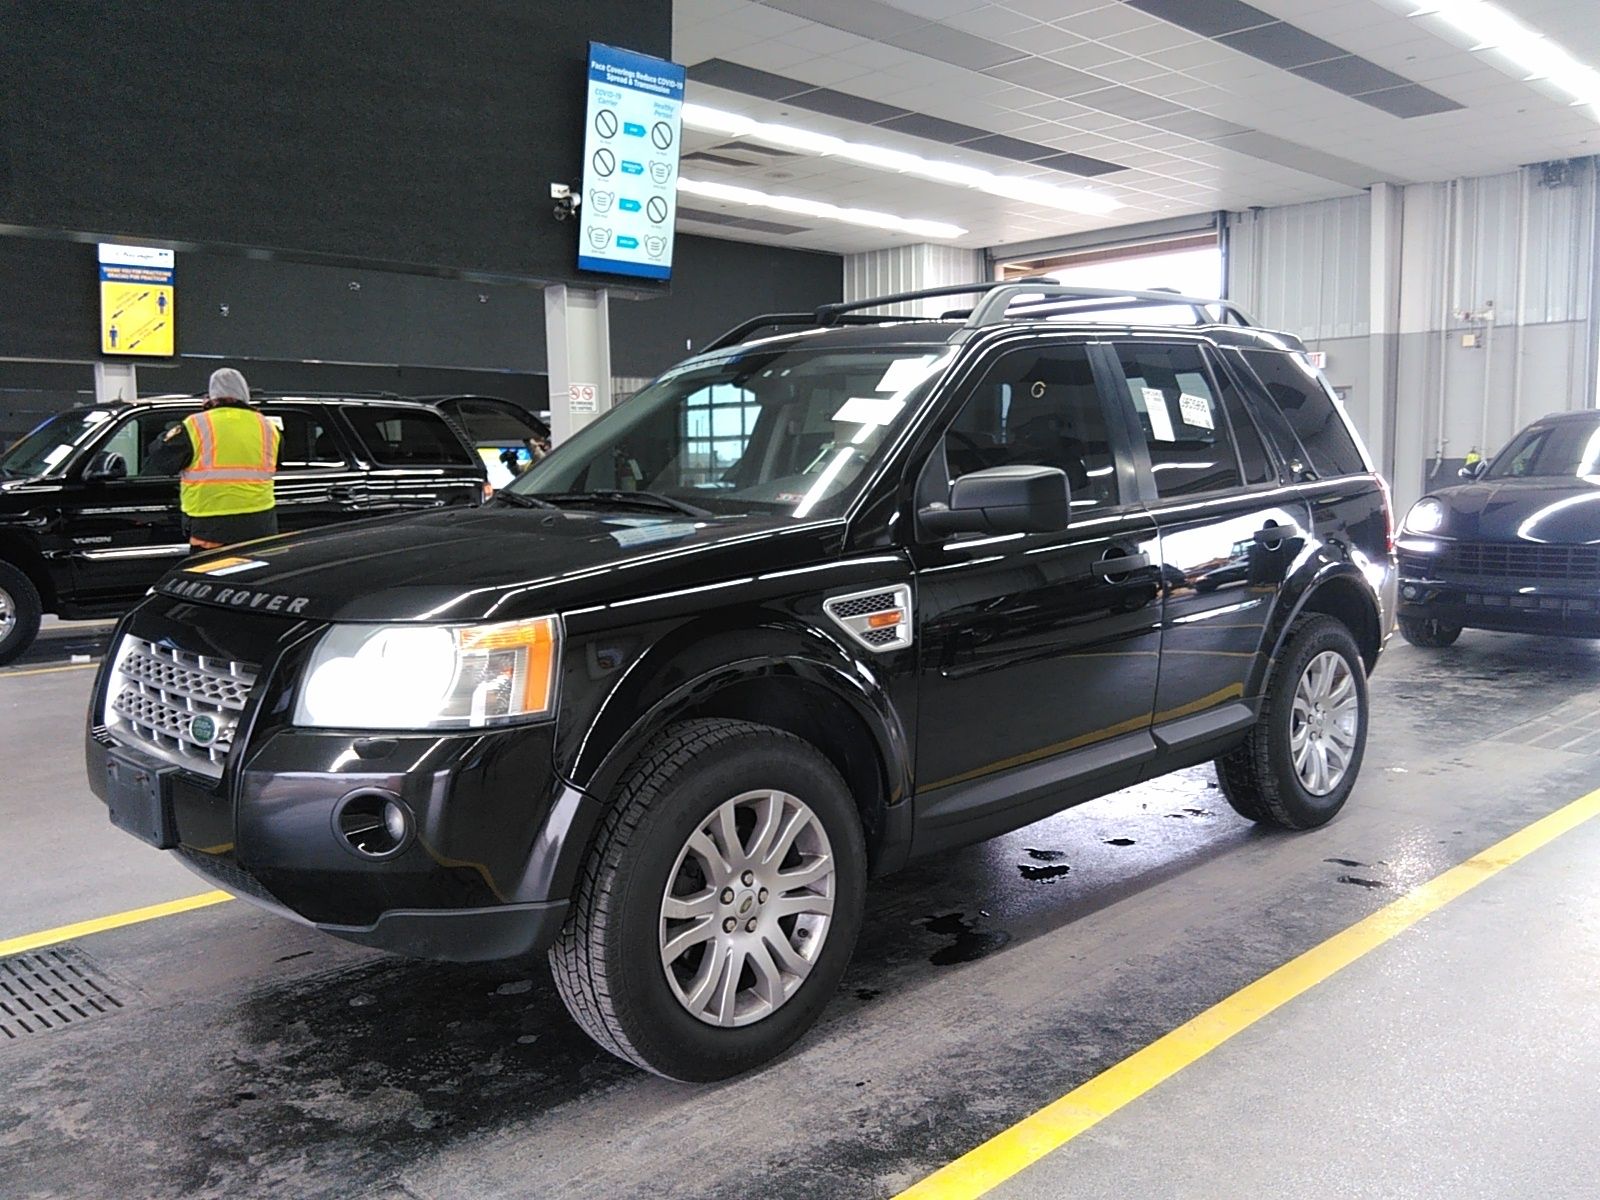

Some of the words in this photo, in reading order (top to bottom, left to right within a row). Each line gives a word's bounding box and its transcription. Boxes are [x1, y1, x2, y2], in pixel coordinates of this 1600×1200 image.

[591, 60, 606, 72] Face
[606, 64, 636, 78] Coverings
[636, 71, 657, 83] Reduce
[657, 77, 684, 90] COVID-19
[606, 72, 628, 85] Spread
[595, 88, 622, 99] COVID-19
[72, 536, 112, 544] YUKON
[163, 578, 213, 598] LAND
[214, 588, 310, 613] ROVER
